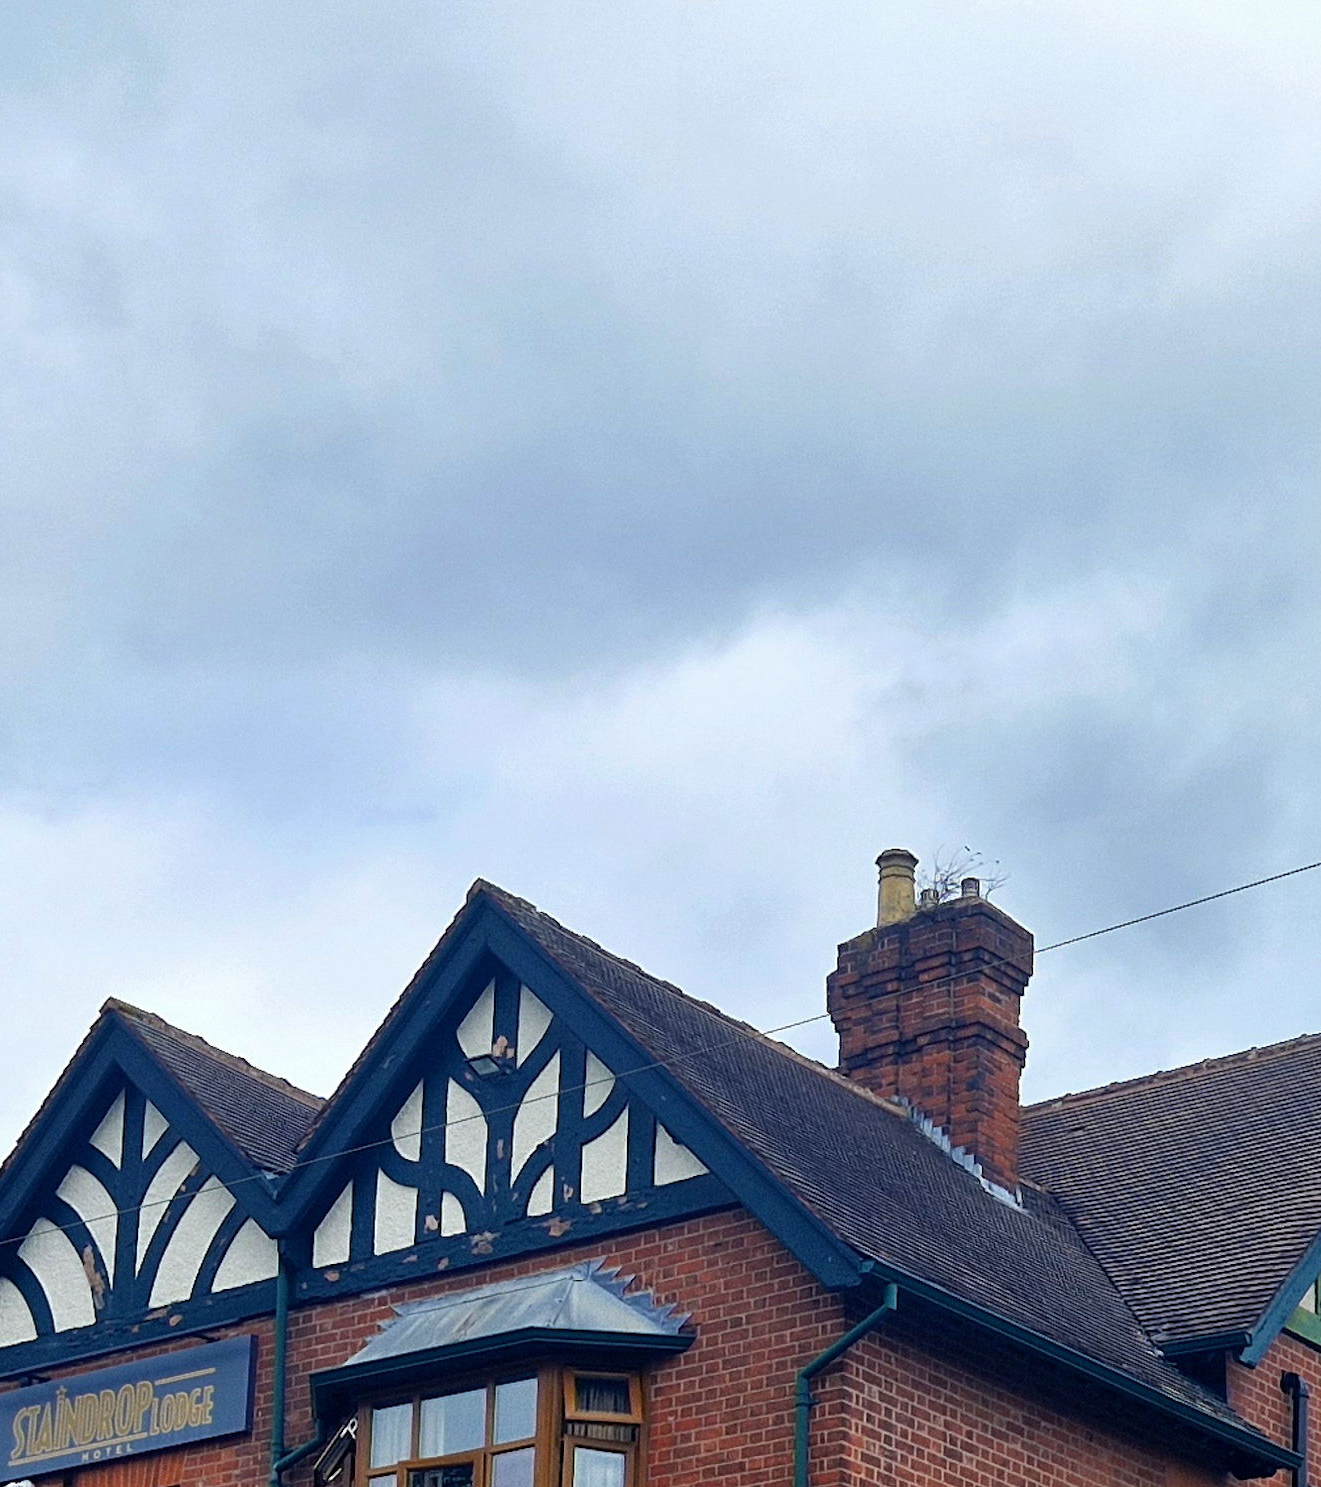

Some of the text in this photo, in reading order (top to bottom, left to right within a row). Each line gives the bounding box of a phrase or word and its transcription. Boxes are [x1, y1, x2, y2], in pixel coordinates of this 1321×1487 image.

[10, 1380, 214, 1460] STAINDROP LODGE
[81, 1443, 133, 1461] HOTEL
